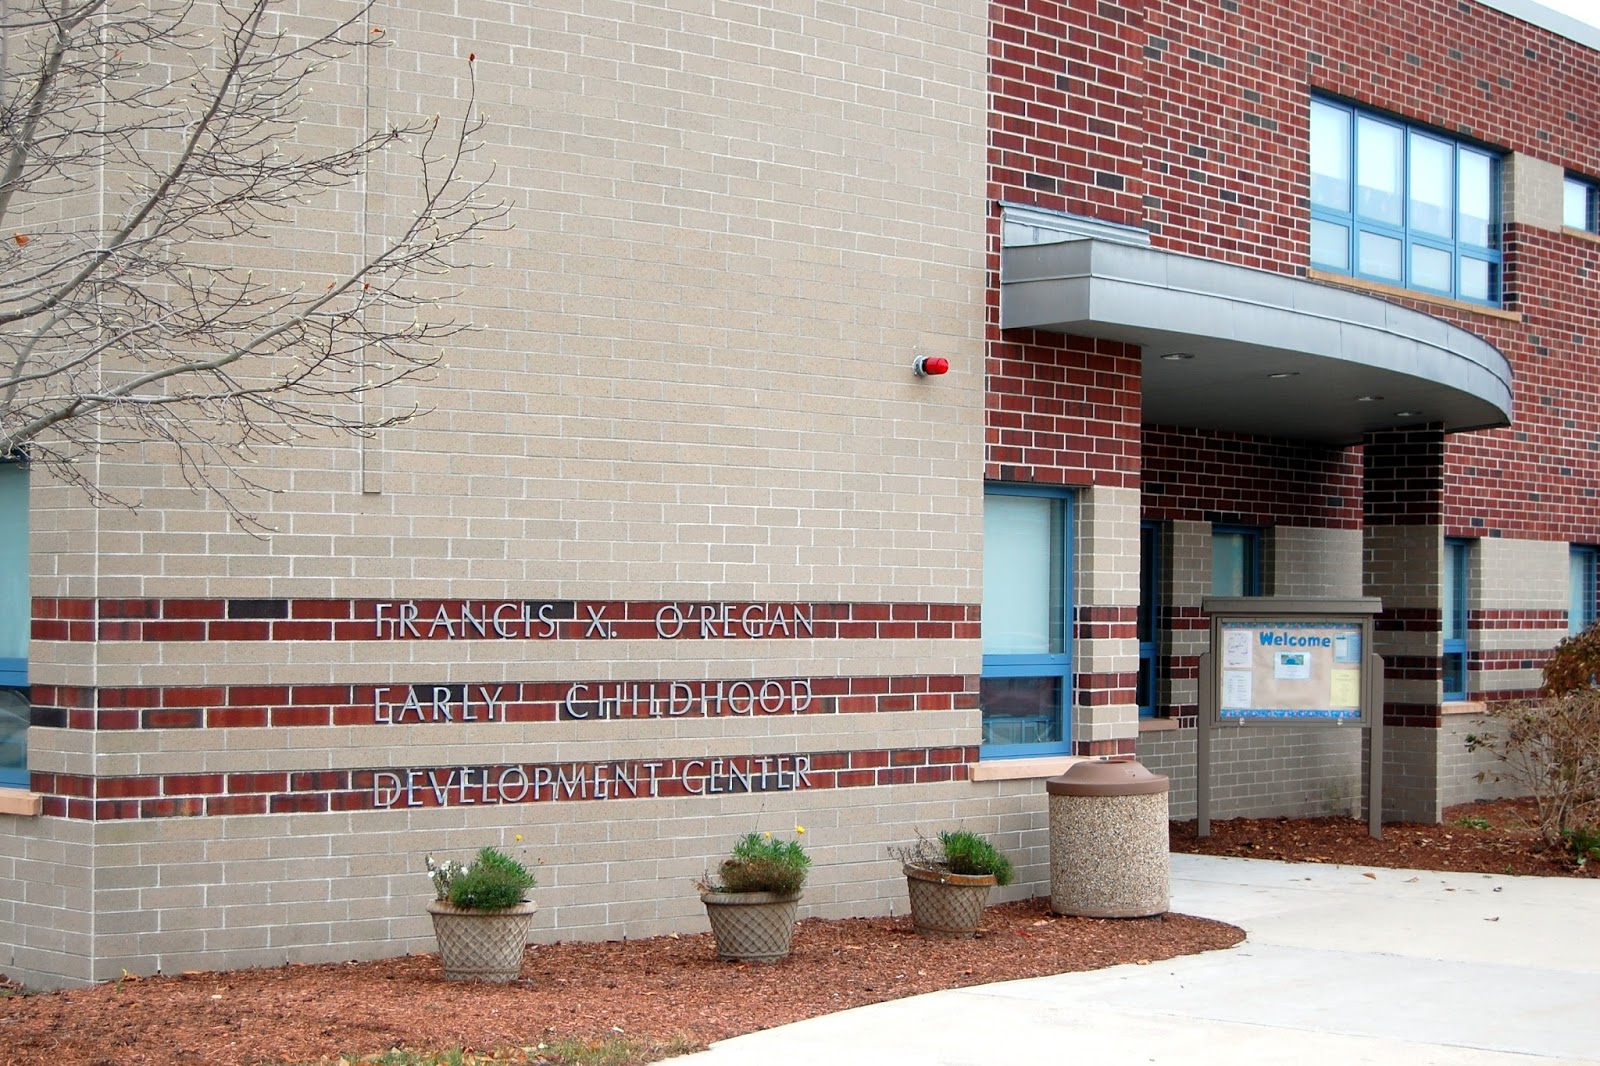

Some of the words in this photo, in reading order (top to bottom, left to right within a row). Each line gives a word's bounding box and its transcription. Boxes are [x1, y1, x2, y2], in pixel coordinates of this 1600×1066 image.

[375, 603, 556, 638] FRANCIS
[585, 604, 618, 638] X.
[655, 604, 813, 638] O'REGAN
[1259, 631, 1331, 648] Welcome
[374, 686, 503, 722] EARLY
[566, 680, 812, 718] CHILDHOOD
[373, 762, 663, 807] DEVELOPMENT
[682, 756, 811, 794] CENTER
